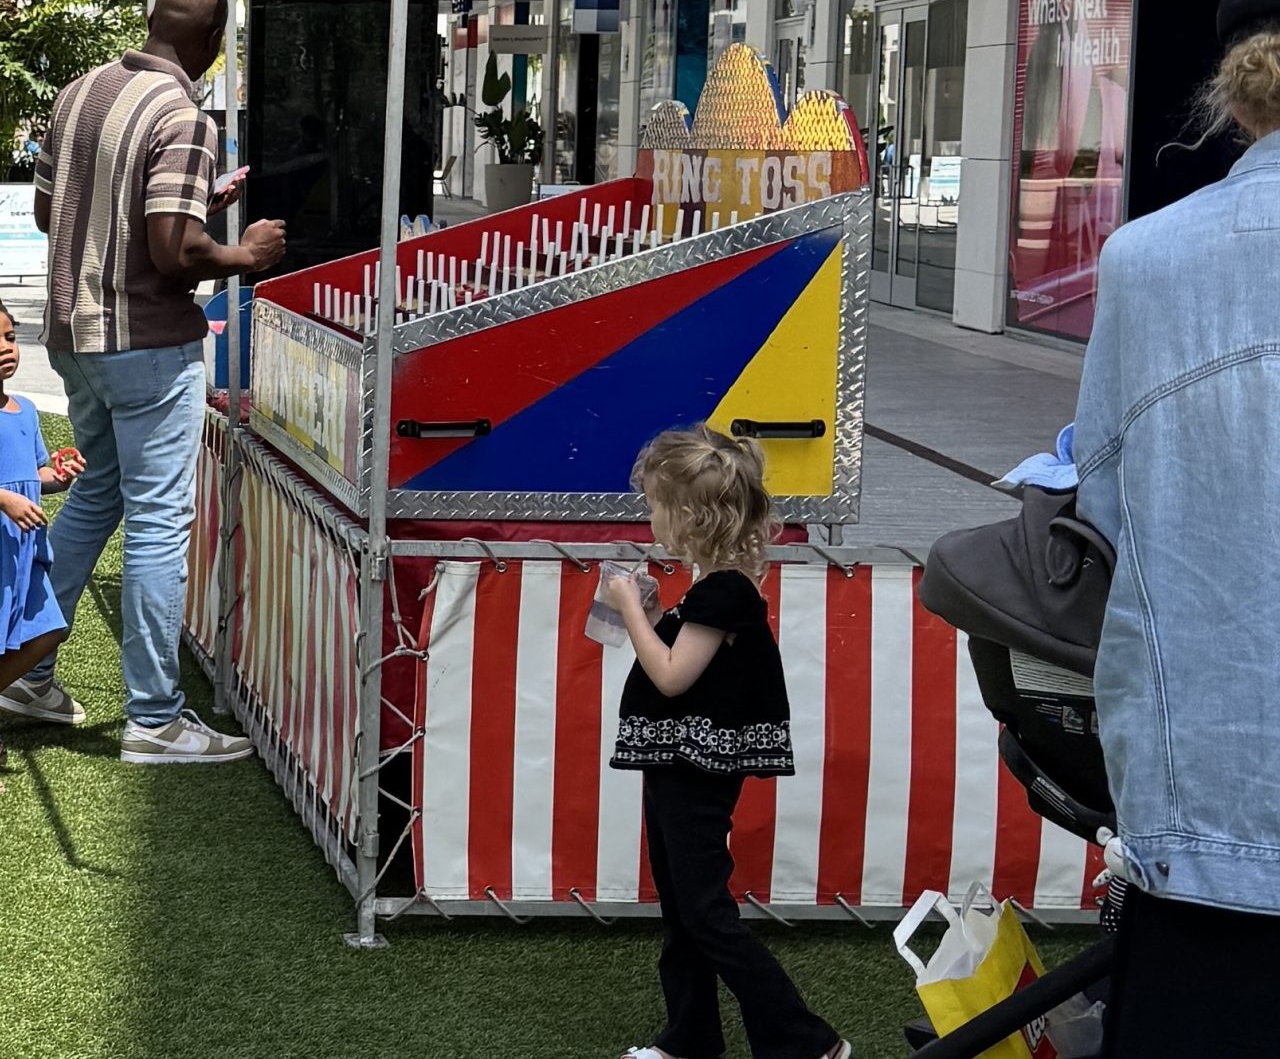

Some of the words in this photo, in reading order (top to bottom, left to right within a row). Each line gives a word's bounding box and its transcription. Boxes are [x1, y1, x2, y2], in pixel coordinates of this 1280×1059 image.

[1071, 27, 1120, 67] Health
[651, 149, 722, 206] RING
[735, 151, 832, 209] TOSS
